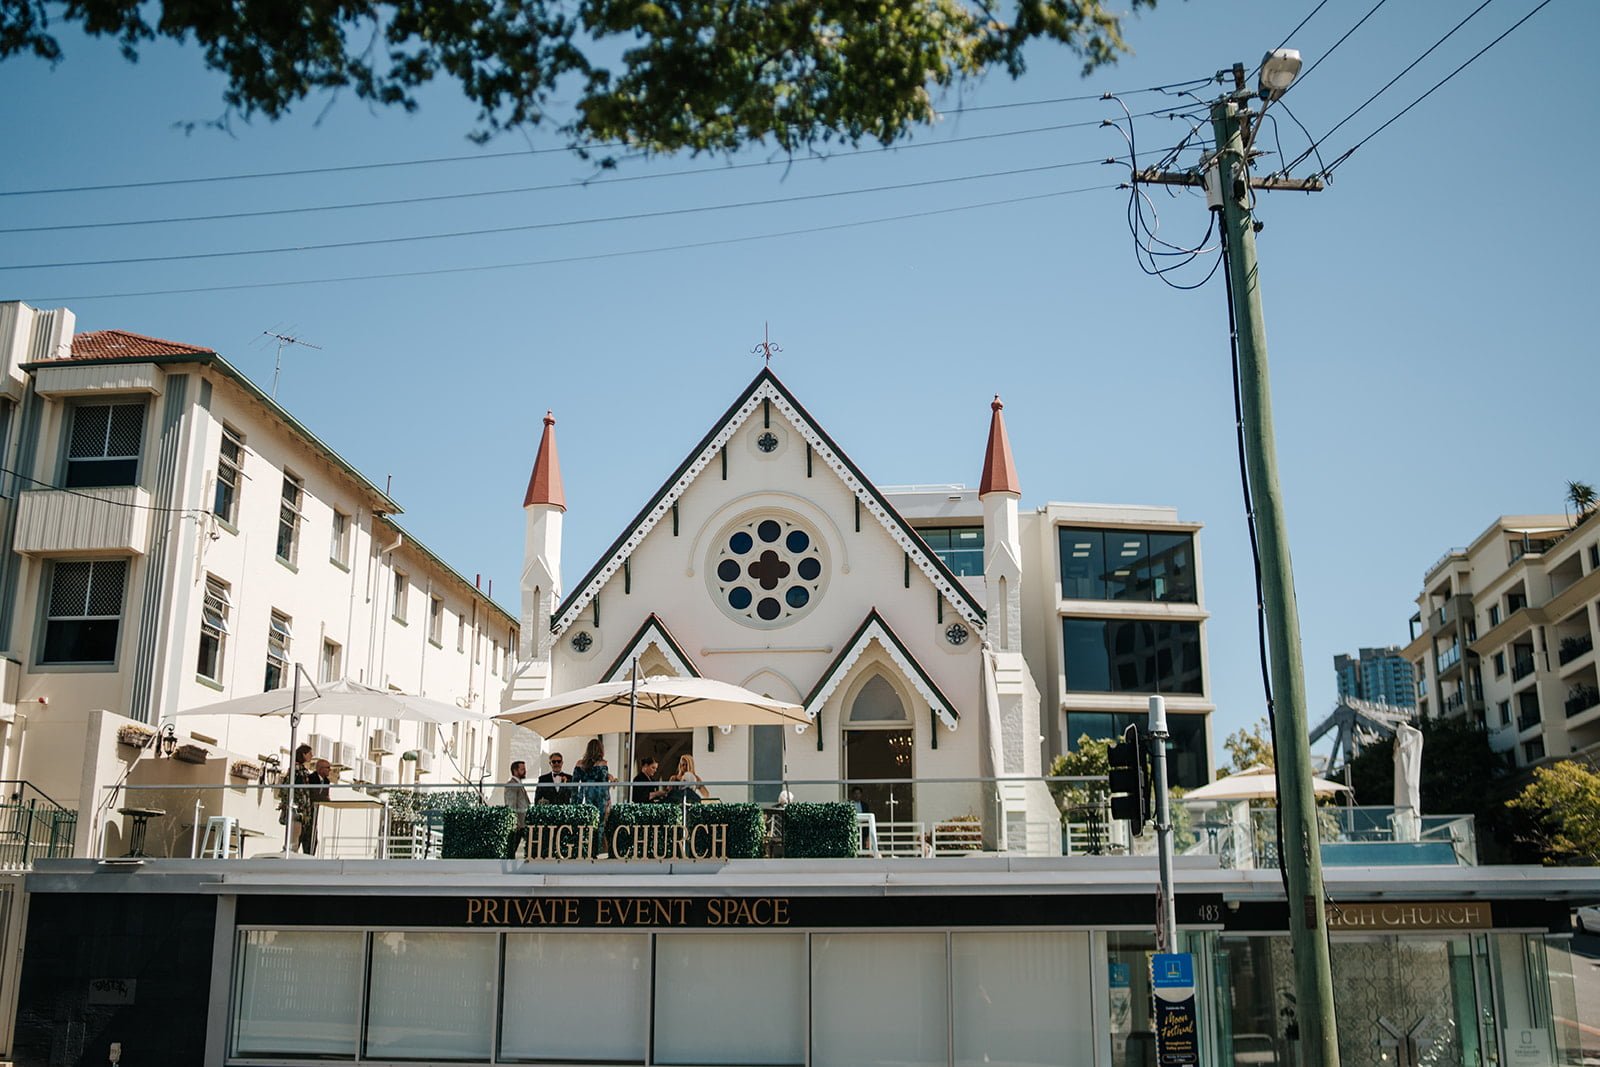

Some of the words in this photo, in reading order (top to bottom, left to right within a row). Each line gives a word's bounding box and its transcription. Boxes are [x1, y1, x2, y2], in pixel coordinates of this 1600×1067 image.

[527, 824, 595, 861] HIGH
[612, 823, 730, 862] CHURCH
[465, 898, 581, 925] PRIVATE
[595, 898, 693, 926] EVENT
[706, 897, 791, 926] SPACE
[1198, 904, 1220, 921] 483
[1381, 905, 1482, 926] CHURCH
